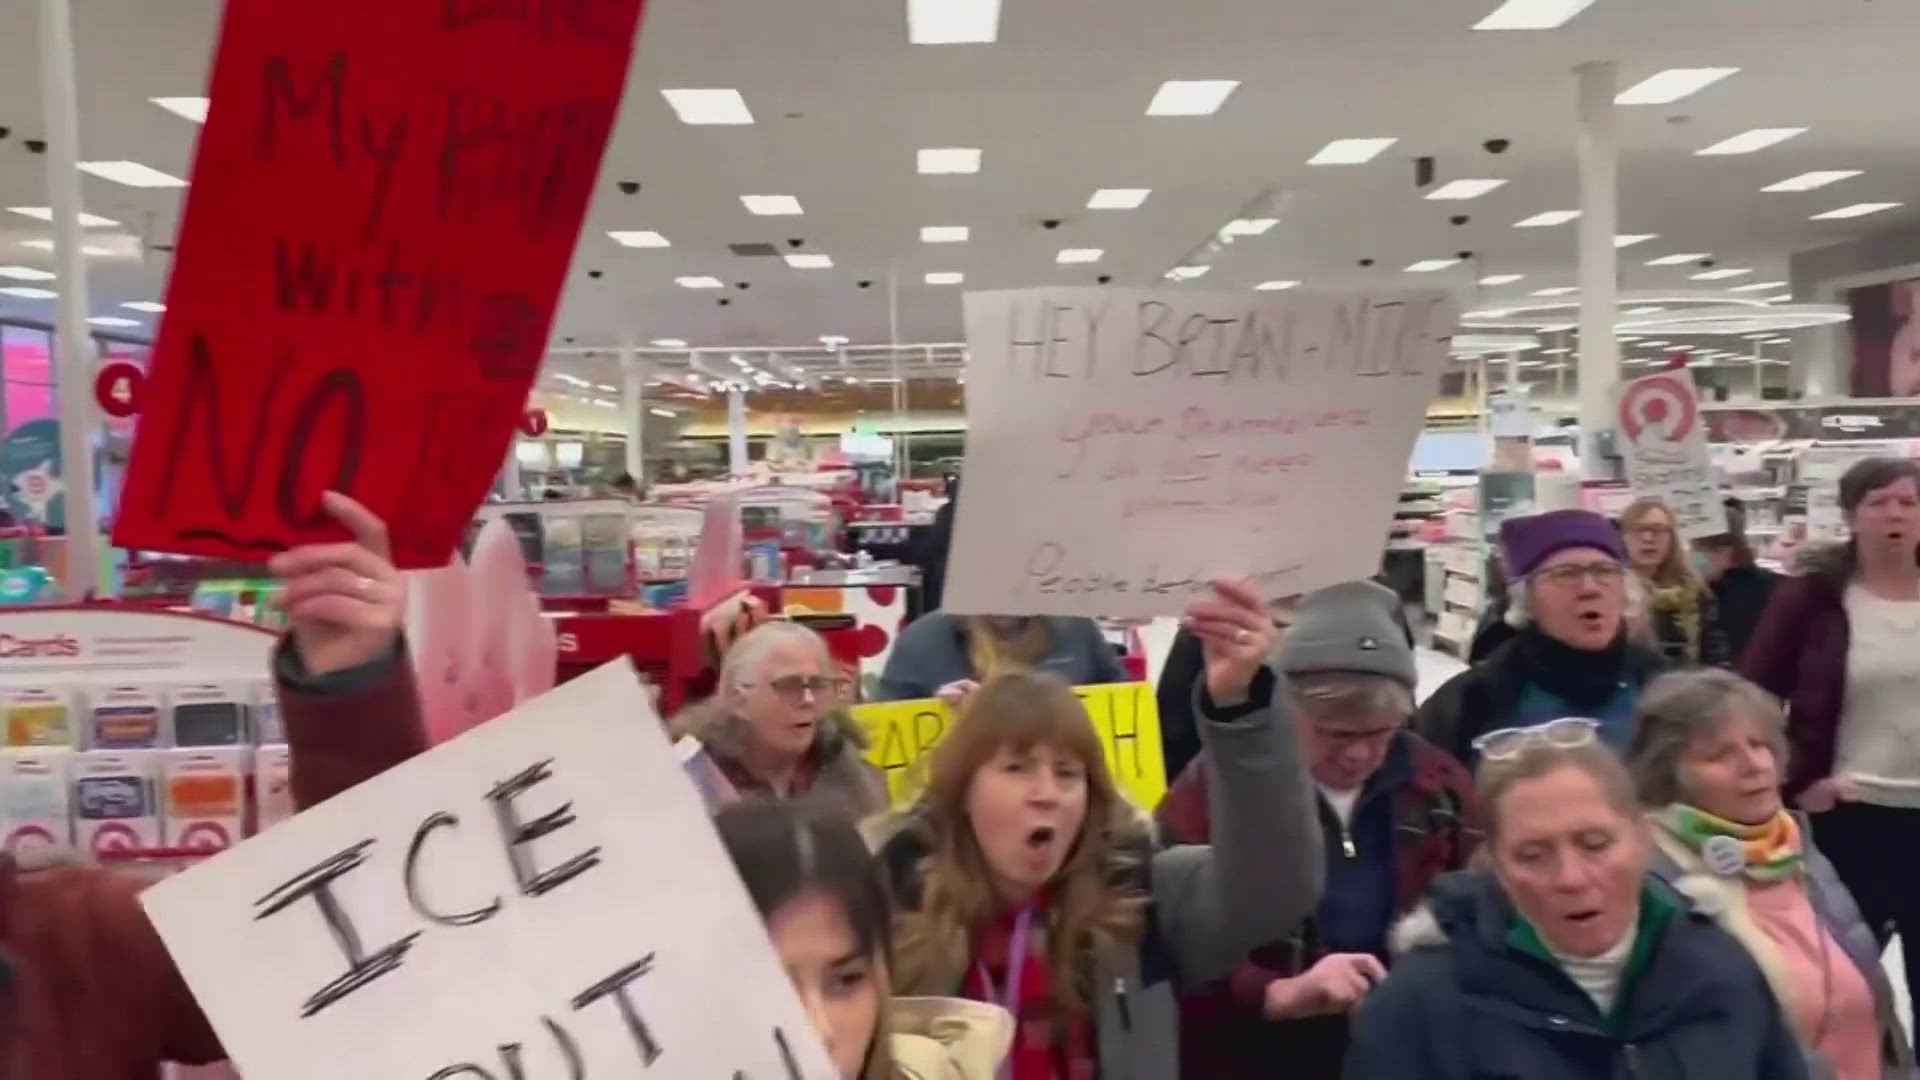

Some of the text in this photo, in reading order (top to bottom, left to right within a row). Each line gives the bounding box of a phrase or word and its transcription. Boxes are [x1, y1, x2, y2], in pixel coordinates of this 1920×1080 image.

[256, 48, 406, 242] My
[110, 376, 132, 404] 4
[152, 328, 368, 534] NO
[1007, 298, 1110, 380] HEY
[252, 756, 602, 1019] ICE
